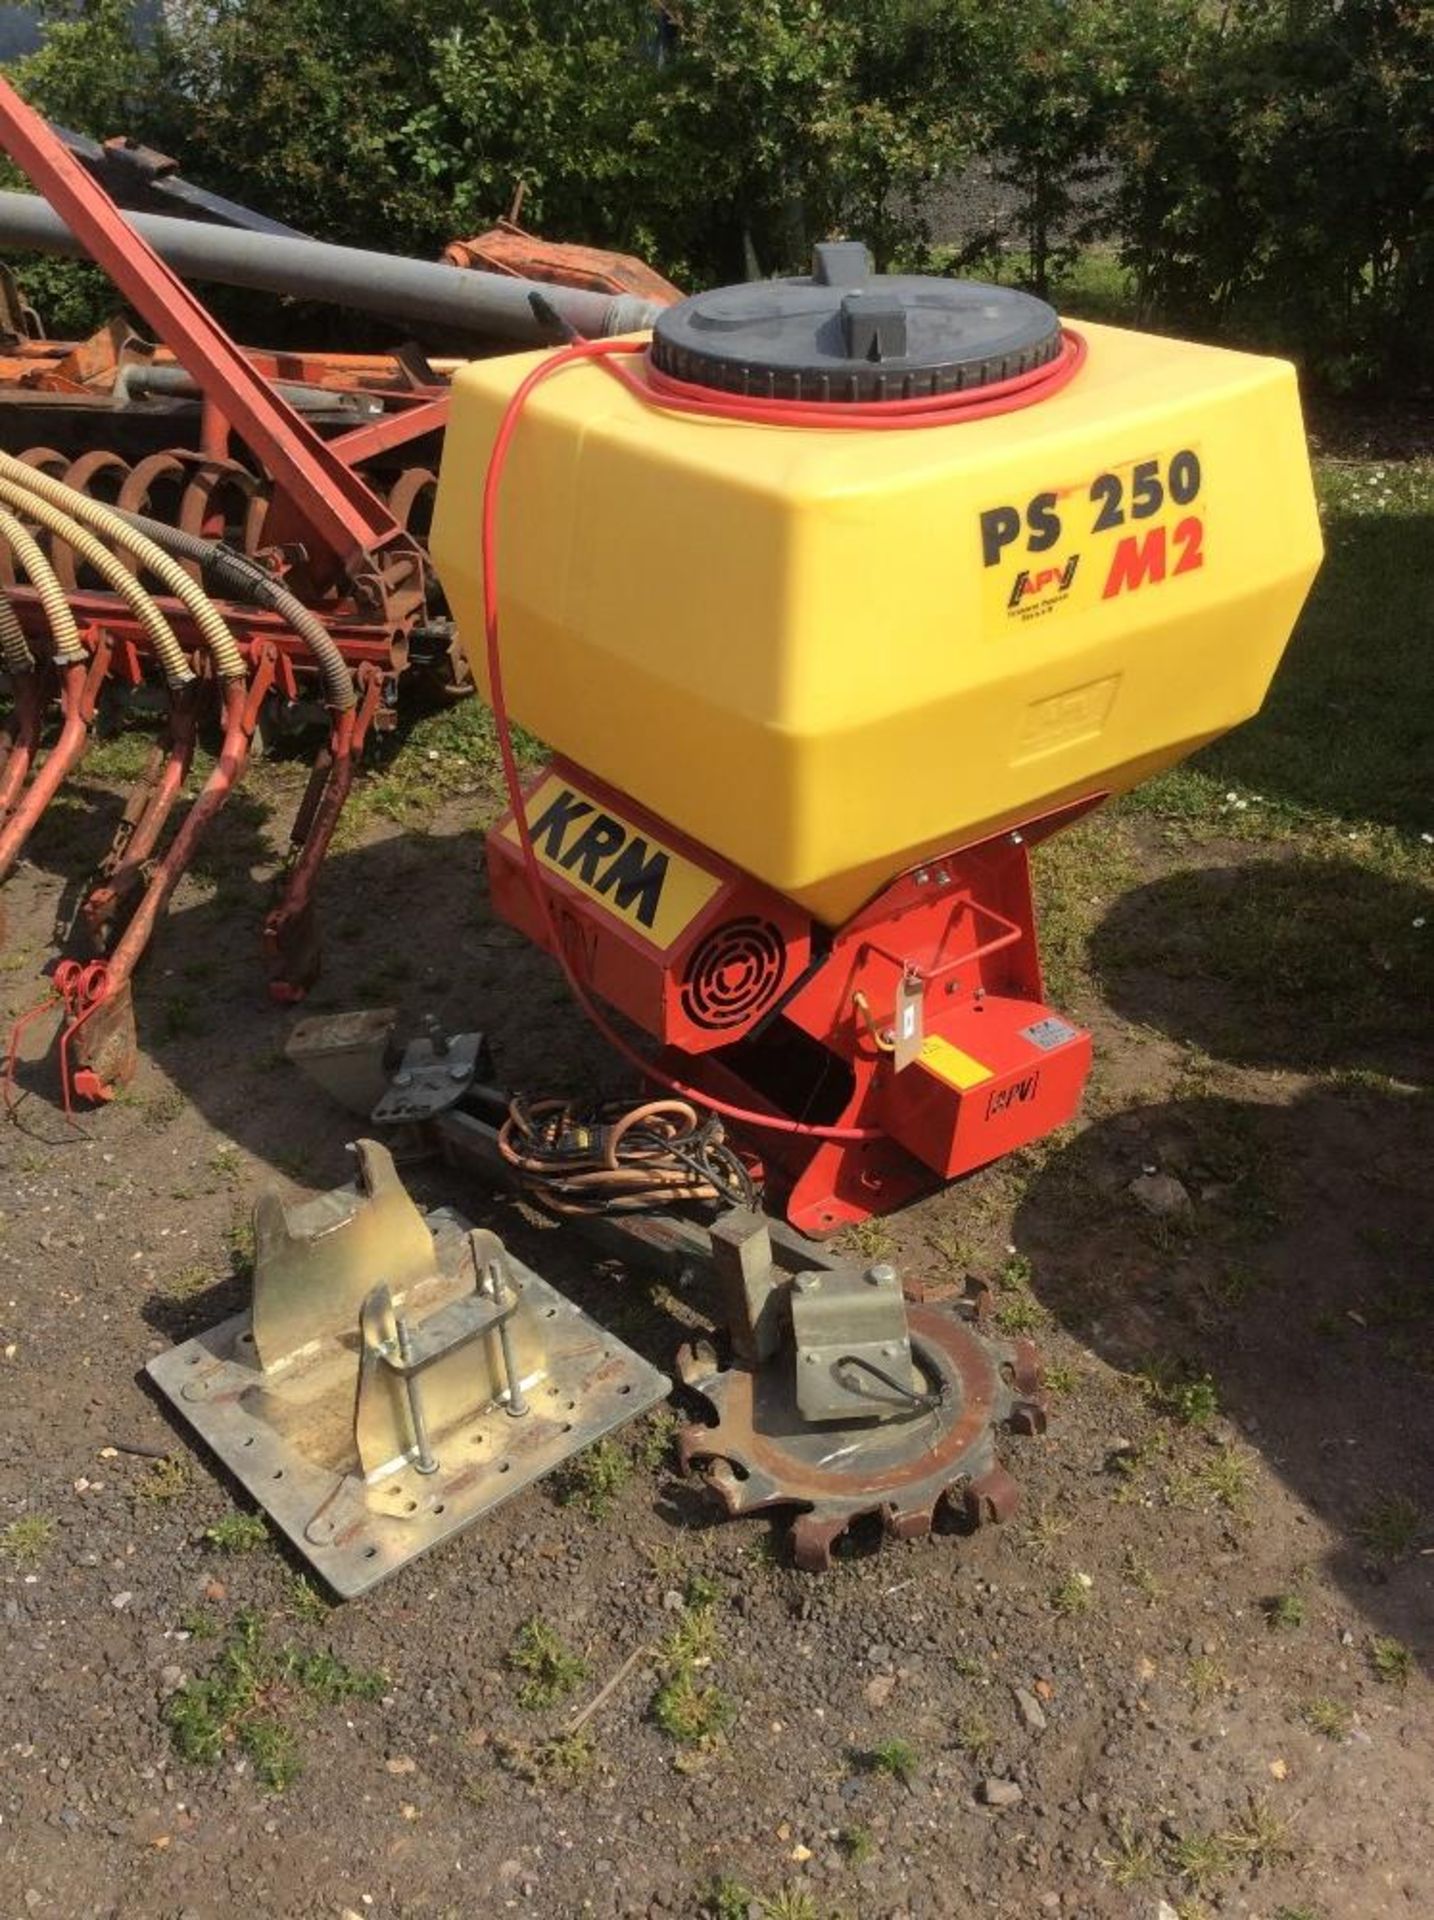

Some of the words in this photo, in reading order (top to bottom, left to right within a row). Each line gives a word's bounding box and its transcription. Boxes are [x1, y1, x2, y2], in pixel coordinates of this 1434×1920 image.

[980, 492, 1062, 568] PS
[1089, 449, 1201, 534] 250
[1101, 515, 1204, 601] M2
[528, 789, 670, 929] KRM
